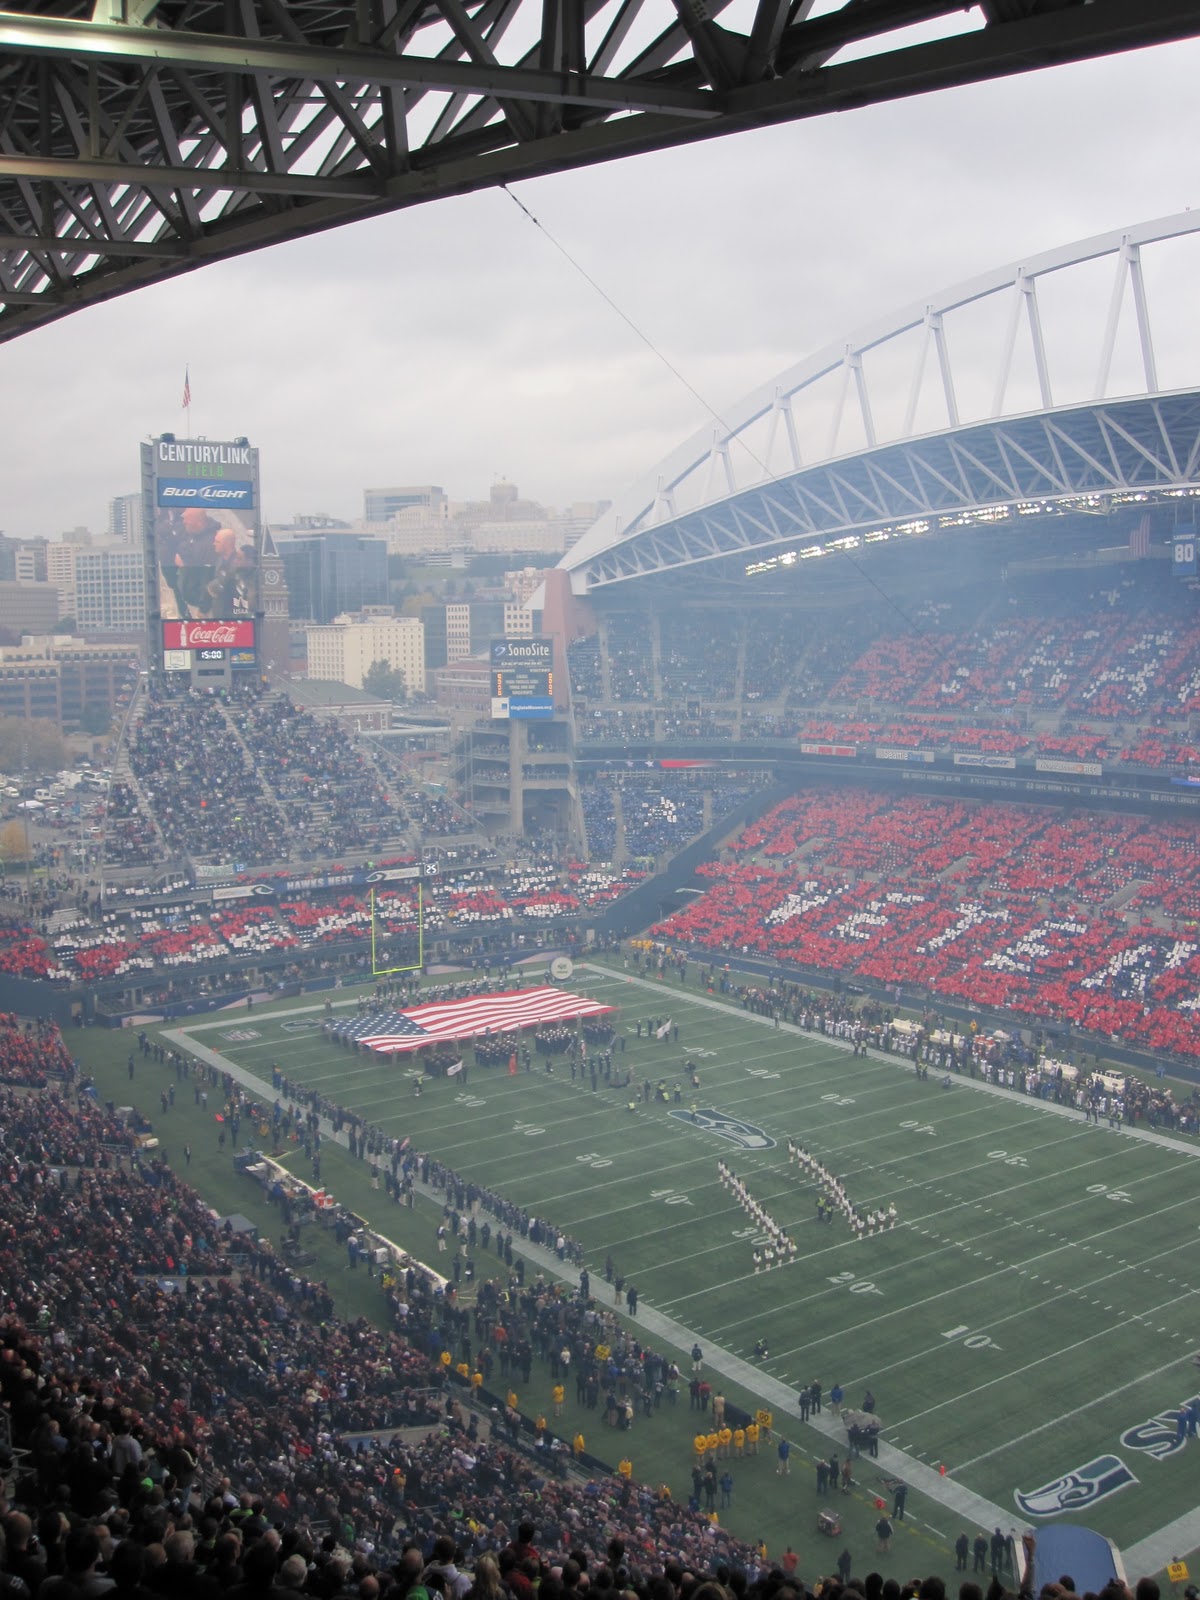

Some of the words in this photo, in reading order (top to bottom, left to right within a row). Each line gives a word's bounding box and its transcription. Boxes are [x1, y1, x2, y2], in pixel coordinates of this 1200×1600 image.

[159, 442, 250, 464] CENTURYLINK
[187, 463, 224, 478] FIELD
[162, 487, 198, 497] BUD
[203, 488, 247, 498] LIGHT
[1175, 544, 1194, 562] 80
[189, 626, 238, 643] Coca-Cola
[508, 643, 549, 656] SonoSite
[426, 864, 437, 874] 25
[287, 878, 324, 890] HAWKS
[328, 875, 354, 887] NEST
